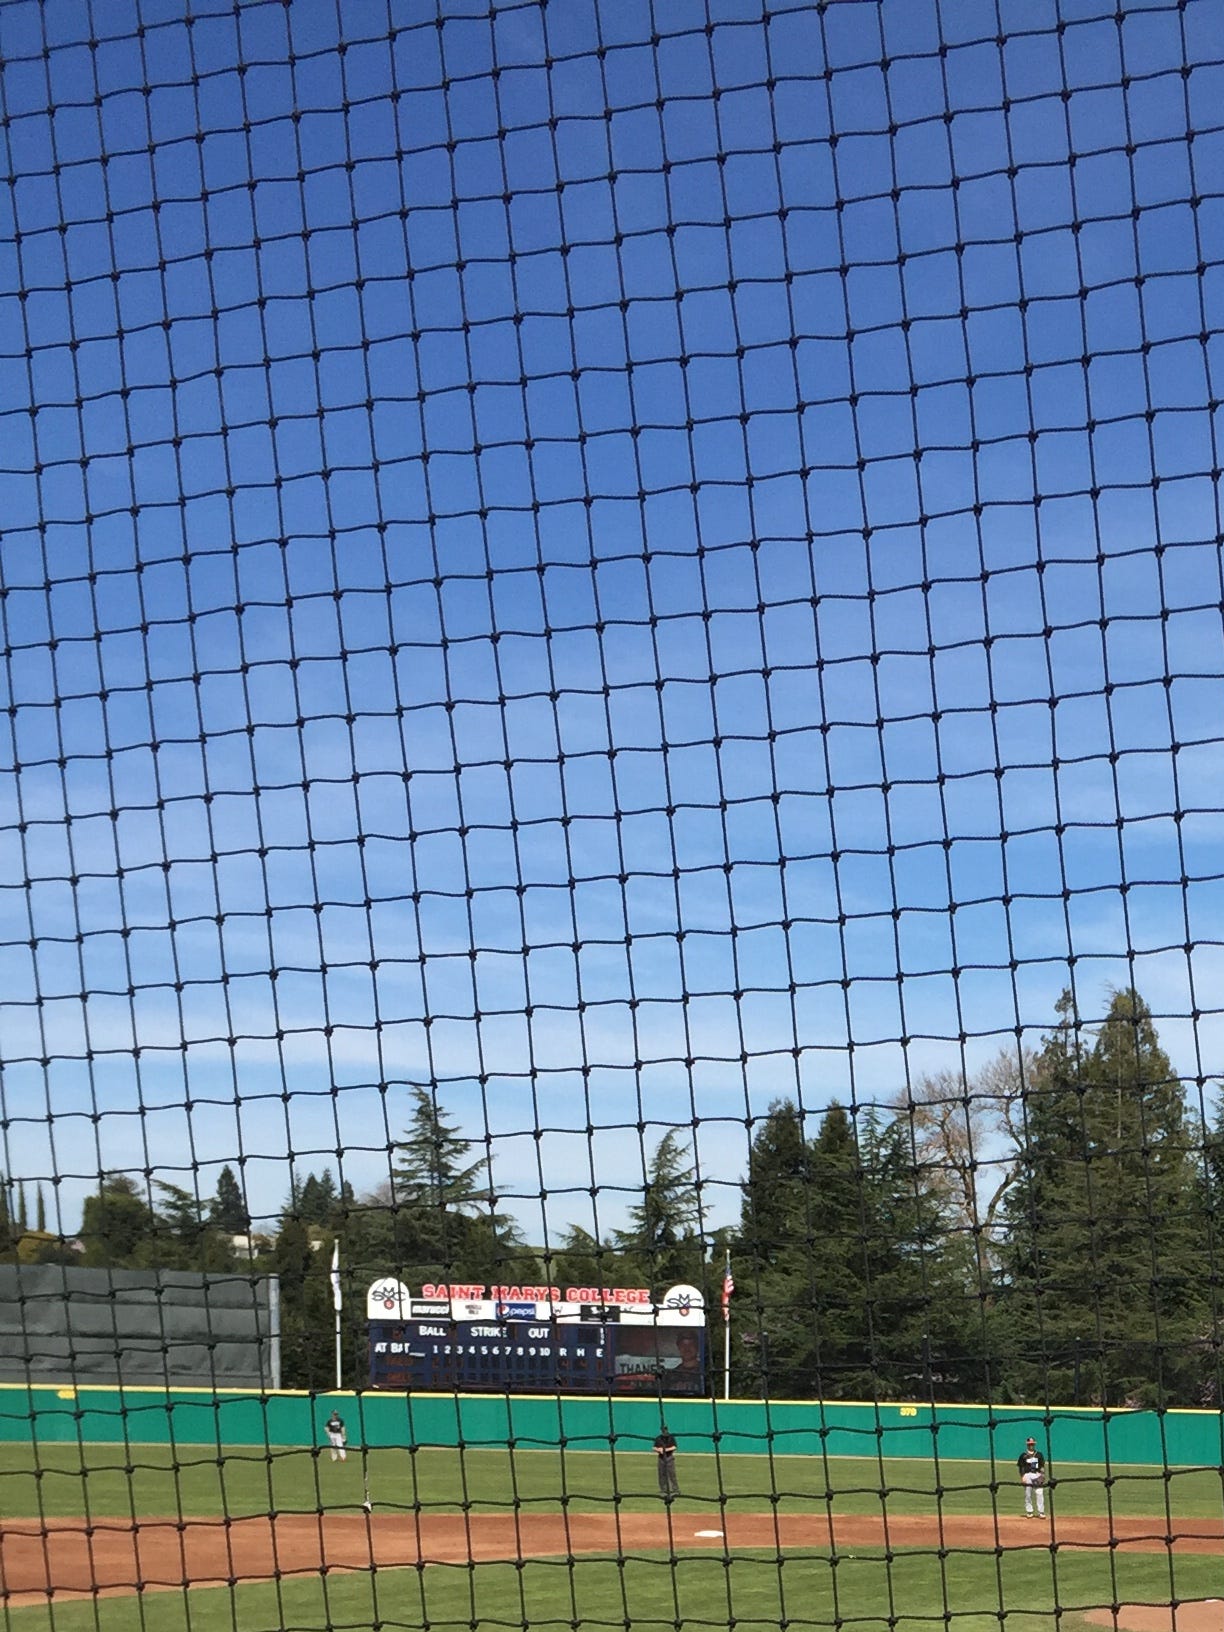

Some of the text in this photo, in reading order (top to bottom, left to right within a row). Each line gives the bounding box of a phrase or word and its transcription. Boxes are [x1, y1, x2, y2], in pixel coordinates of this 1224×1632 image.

[422, 1284, 650, 1304] SAINT MARYS COLLEGE
[510, 1307, 535, 1317] pepsi
[419, 1326, 446, 1337] BALL
[471, 1326, 508, 1338] STRIKE
[528, 1328, 550, 1339] OUT
[374, 1342, 388, 1353] AT
[433, 1345, 439, 1354] 1
[444, 1345, 451, 1354] 2
[456, 1345, 464, 1355] 3
[469, 1345, 476, 1354] 4
[481, 1346, 488, 1355] 5
[492, 1346, 500, 1355] 6
[505, 1346, 512, 1355] 7
[516, 1347, 524, 1356] 8
[529, 1347, 537, 1356] 9
[540, 1347, 550, 1356] 10
[560, 1347, 567, 1356] R
[596, 1348, 604, 1357] E
